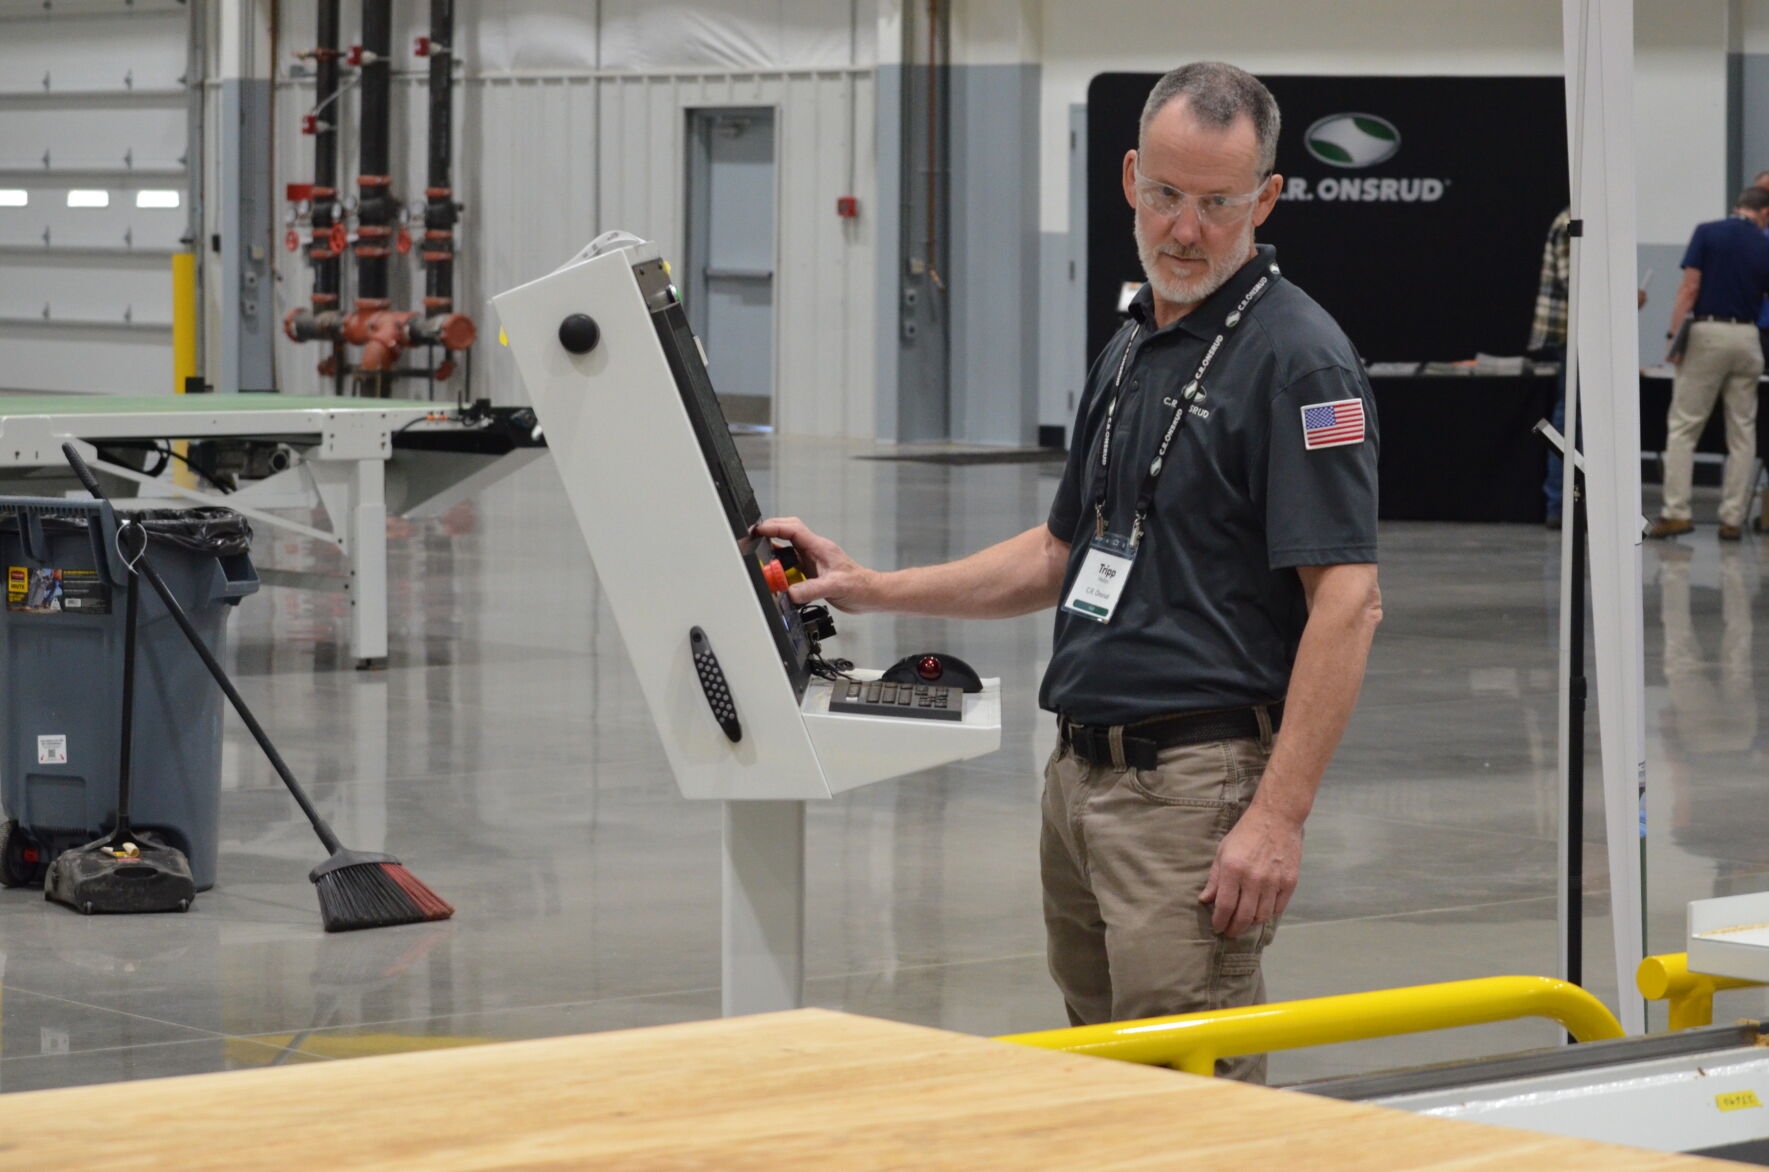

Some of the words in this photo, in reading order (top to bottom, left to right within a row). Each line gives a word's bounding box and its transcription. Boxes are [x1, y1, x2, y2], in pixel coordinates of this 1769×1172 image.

[1280, 177, 1313, 201] .R.
[1317, 178, 1444, 202] ONSRUD
[1189, 404, 1210, 418] SRUD
[1099, 563, 1116, 579] Tripp
